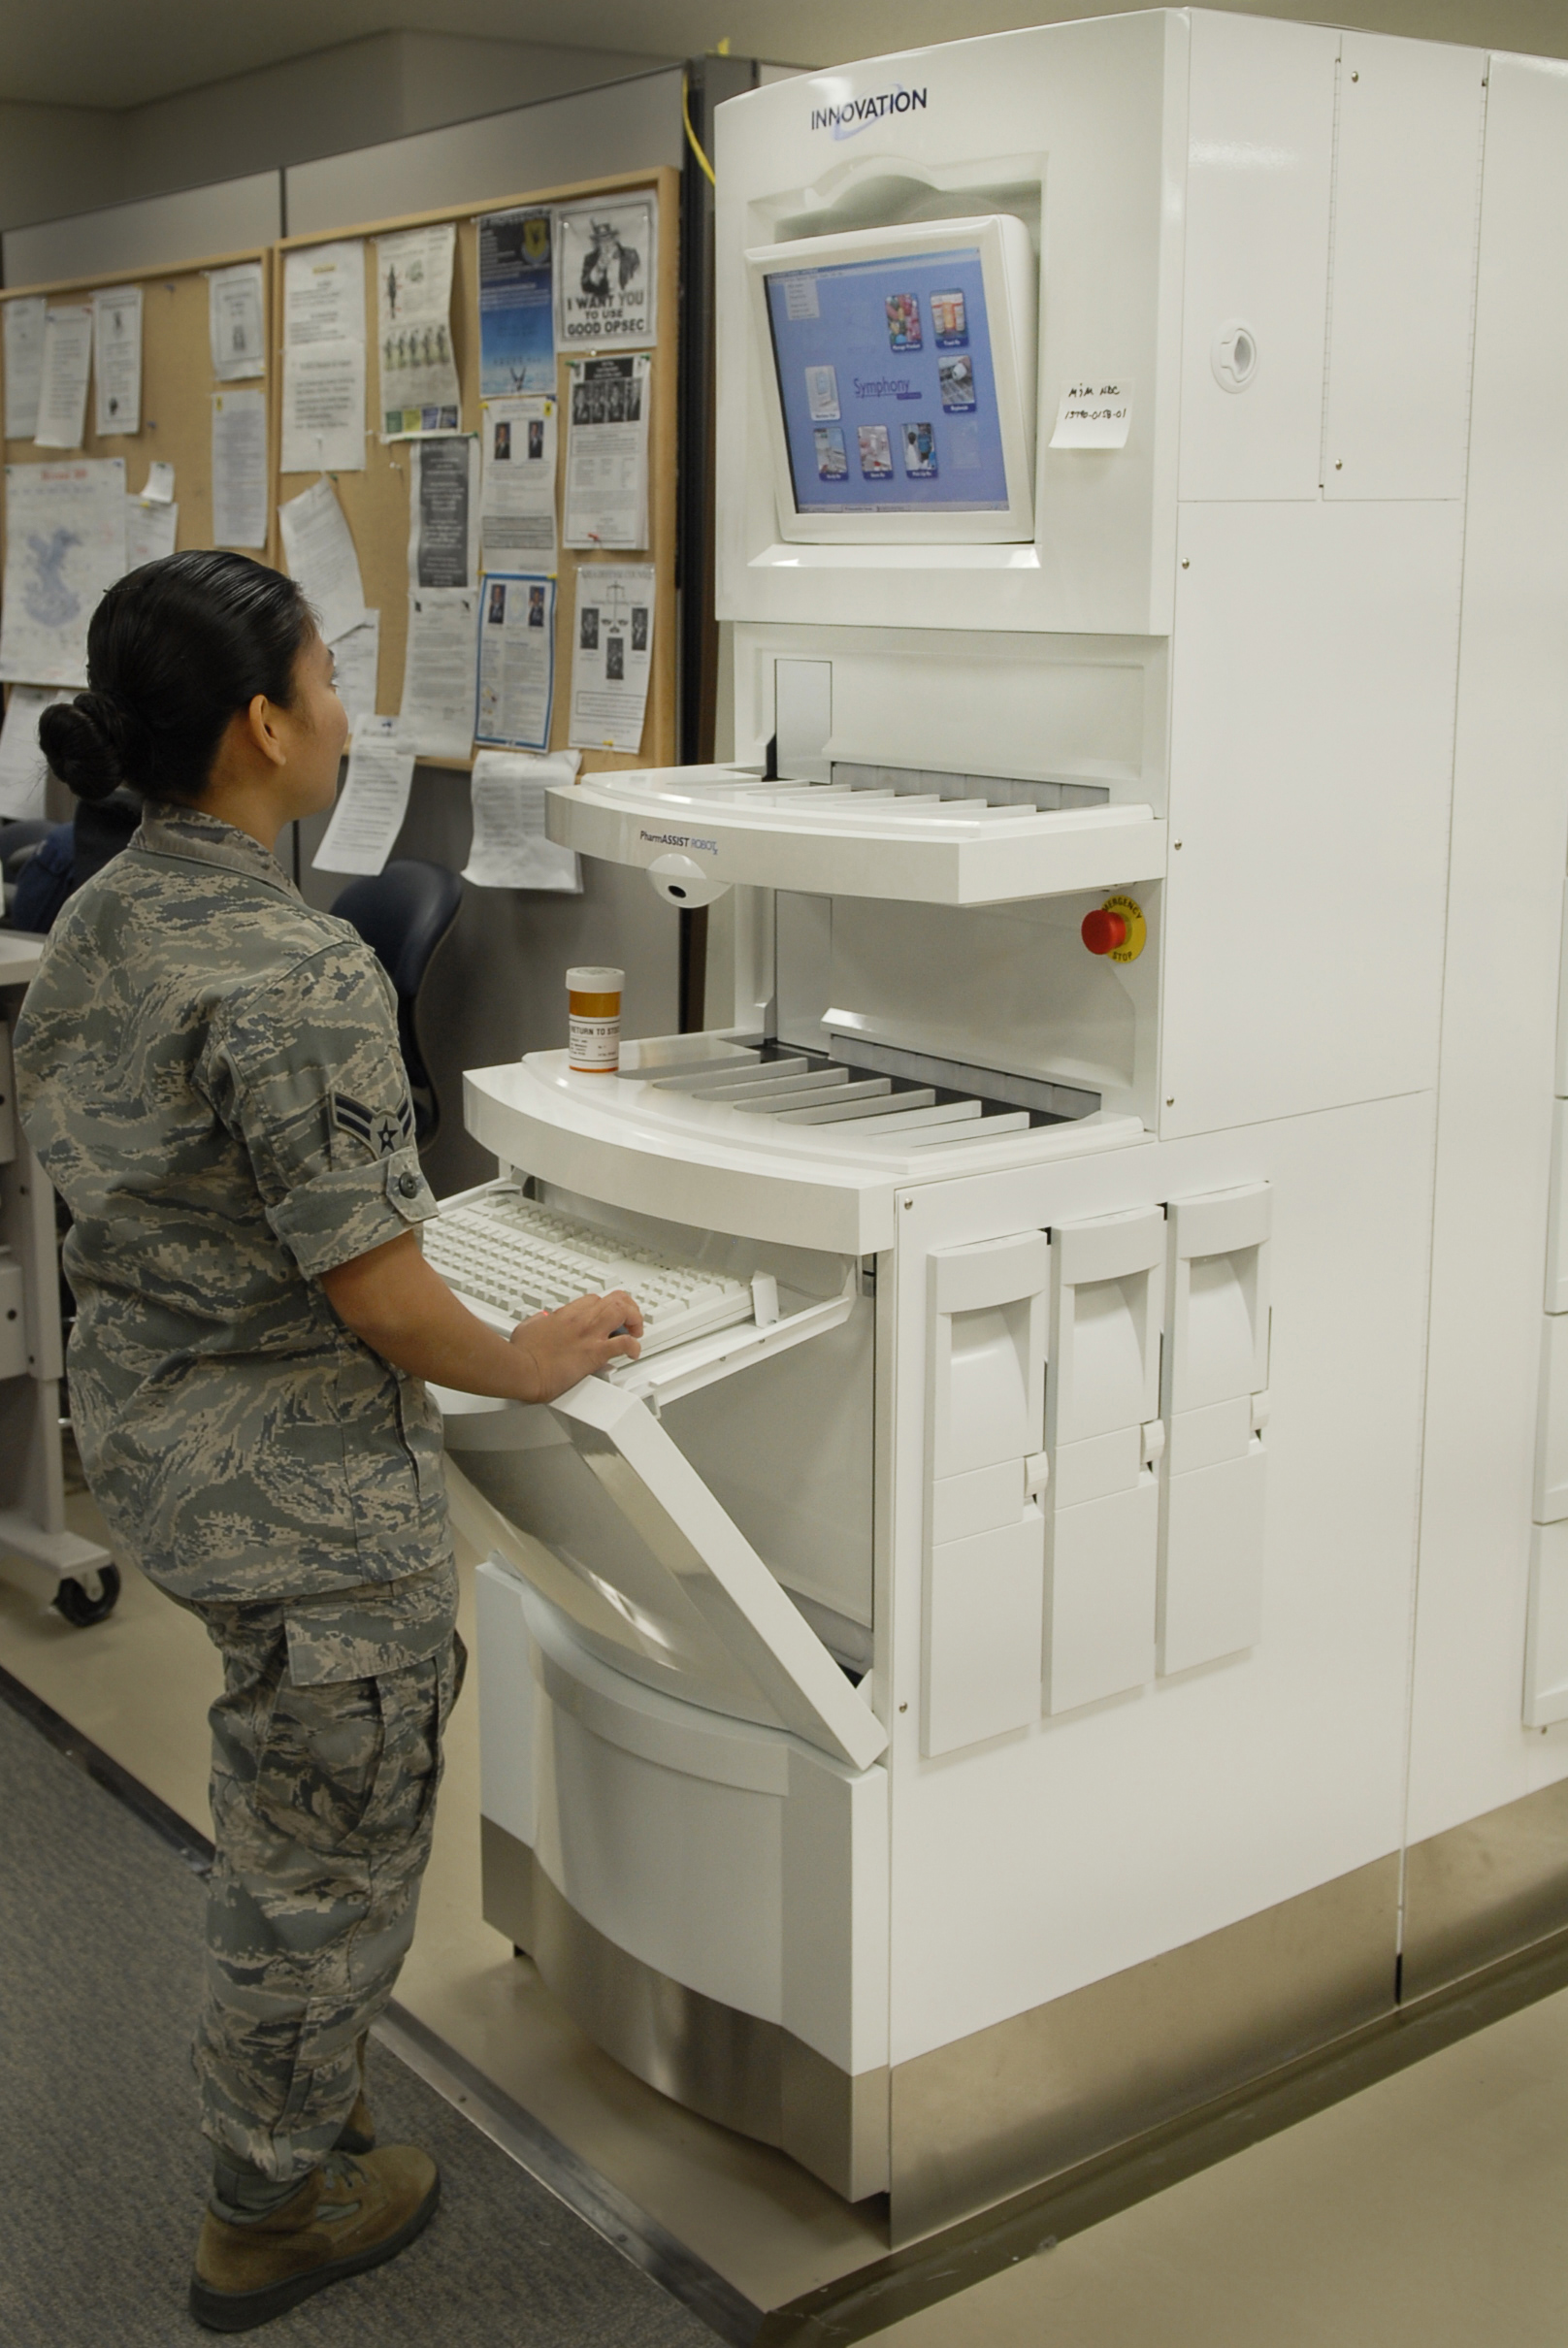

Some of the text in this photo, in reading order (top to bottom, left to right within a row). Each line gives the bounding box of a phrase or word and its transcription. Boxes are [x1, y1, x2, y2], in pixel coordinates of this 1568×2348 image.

[811, 87, 928, 130] INNOVATION
[568, 292, 644, 310] I WANT YOU
[602, 310, 623, 319] USE
[568, 318, 644, 335] GOOD OPSEC
[854, 375, 910, 398] Symphony
[639, 830, 690, 847] PharmASSIST
[1102, 897, 1143, 919] MERGENCY
[1112, 951, 1132, 962] STOP
